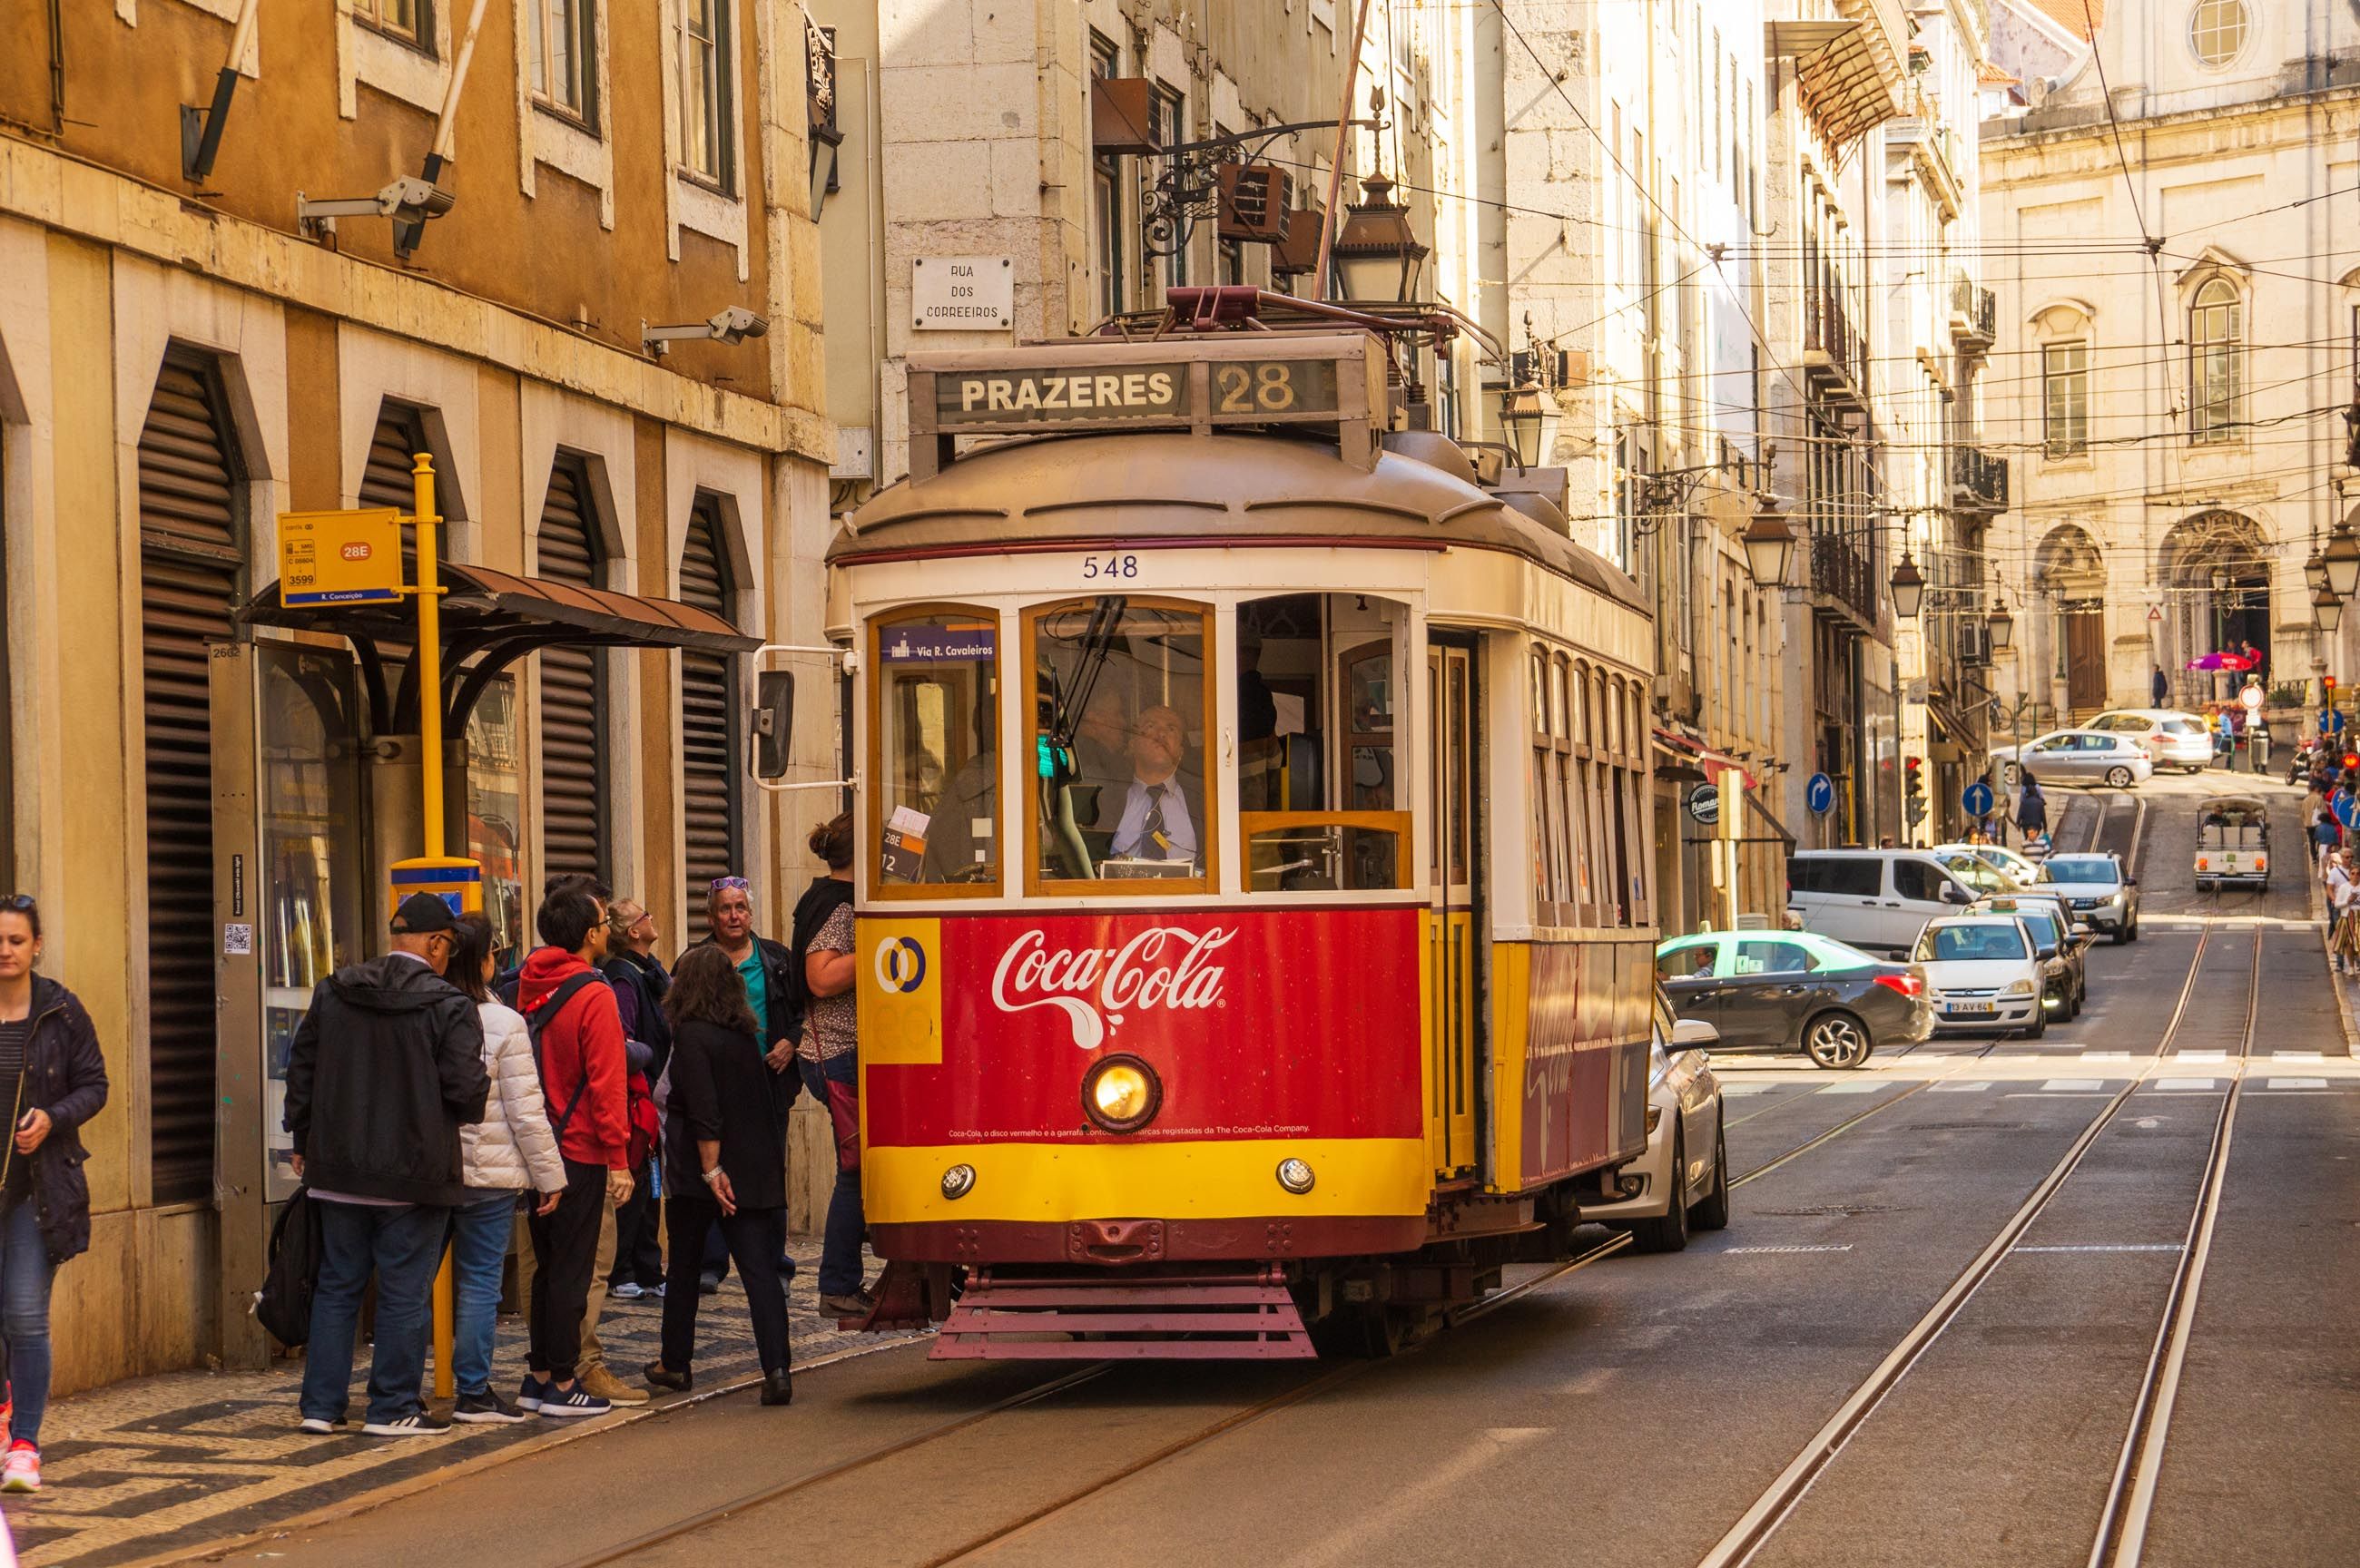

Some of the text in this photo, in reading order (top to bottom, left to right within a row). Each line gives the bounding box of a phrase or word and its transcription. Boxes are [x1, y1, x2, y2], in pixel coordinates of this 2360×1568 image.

[950, 265, 974, 277] RUA
[951, 286, 974, 297] DOS
[927, 307, 998, 318] CORREEIROS
[961, 363, 1294, 412] PRAZERES 28
[344, 545, 369, 557] 28E
[1083, 555, 1137, 578] 548
[290, 575, 313, 585] 3599
[917, 644, 993, 657] Via R. Cavaleiros
[884, 832, 901, 847] 28E
[992, 926, 1239, 1050] Coca-Cola
[949, 1130, 983, 1138] Coca-Cola,
[1057, 1129, 1084, 1138] garrafa
[1163, 1127, 1202, 1137] registadas
[1233, 1125, 1272, 1133] Coca-Cola
[1273, 1124, 1311, 1134] Company.
